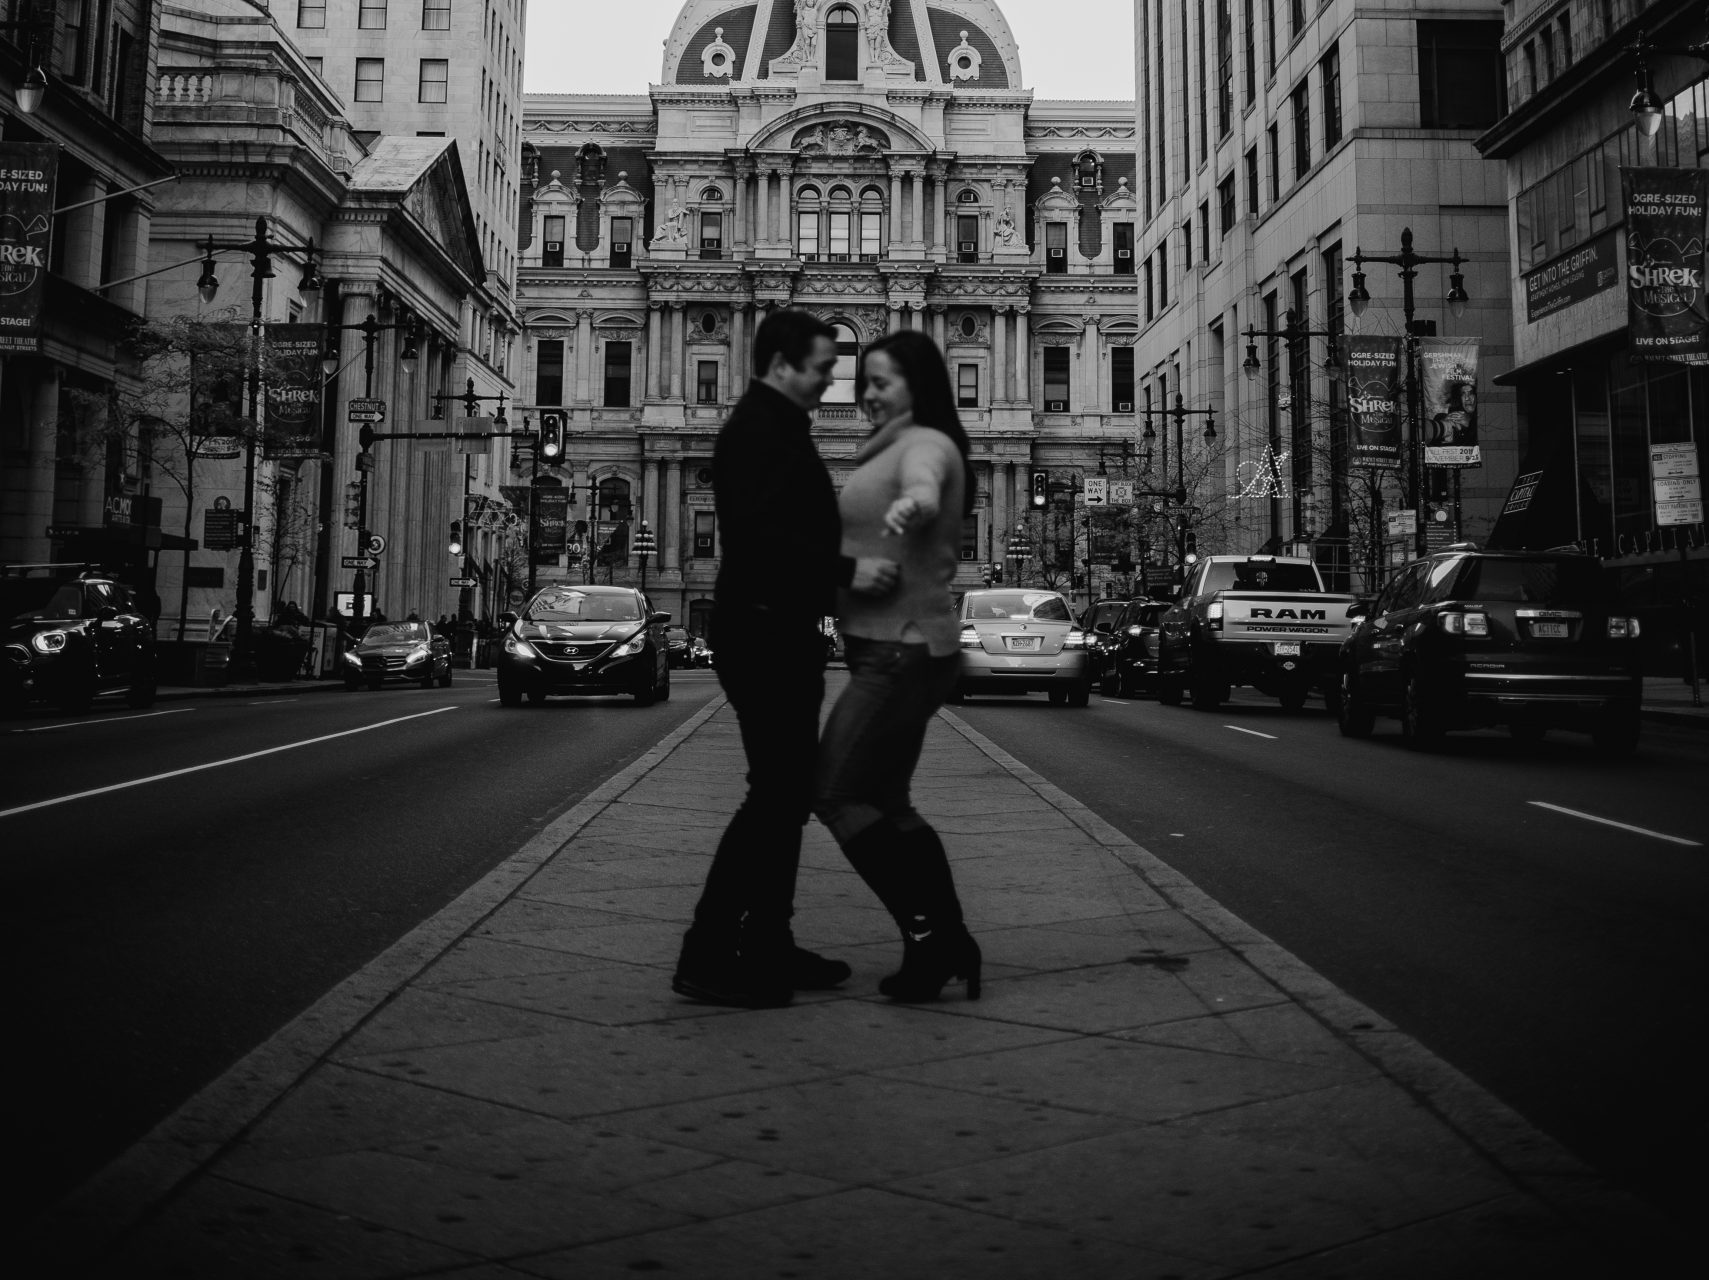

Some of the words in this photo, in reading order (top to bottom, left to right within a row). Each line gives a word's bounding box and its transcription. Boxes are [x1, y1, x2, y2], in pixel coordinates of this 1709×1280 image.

[21, 182, 48, 193] FUN!
[1632, 193, 1697, 205] OGRE-SIZED
[1628, 205, 1673, 216] HOLIDAY
[1675, 206, 1702, 217] FUN!
[1529, 273, 1541, 292] GET
[1541, 266, 1557, 287] INTO
[1557, 258, 1570, 279] THE
[14, 336, 38, 346] THEATRE
[1635, 337, 1654, 345] LIVE
[1655, 336, 1668, 345] ON
[1669, 334, 1700, 345] STAGE!
[1351, 352, 1396, 360] OGRE-SIZED
[1347, 359, 1381, 367] HOLIDAY
[349, 402, 379, 411] CHESTNUT
[1250, 608, 1326, 620] RAM
